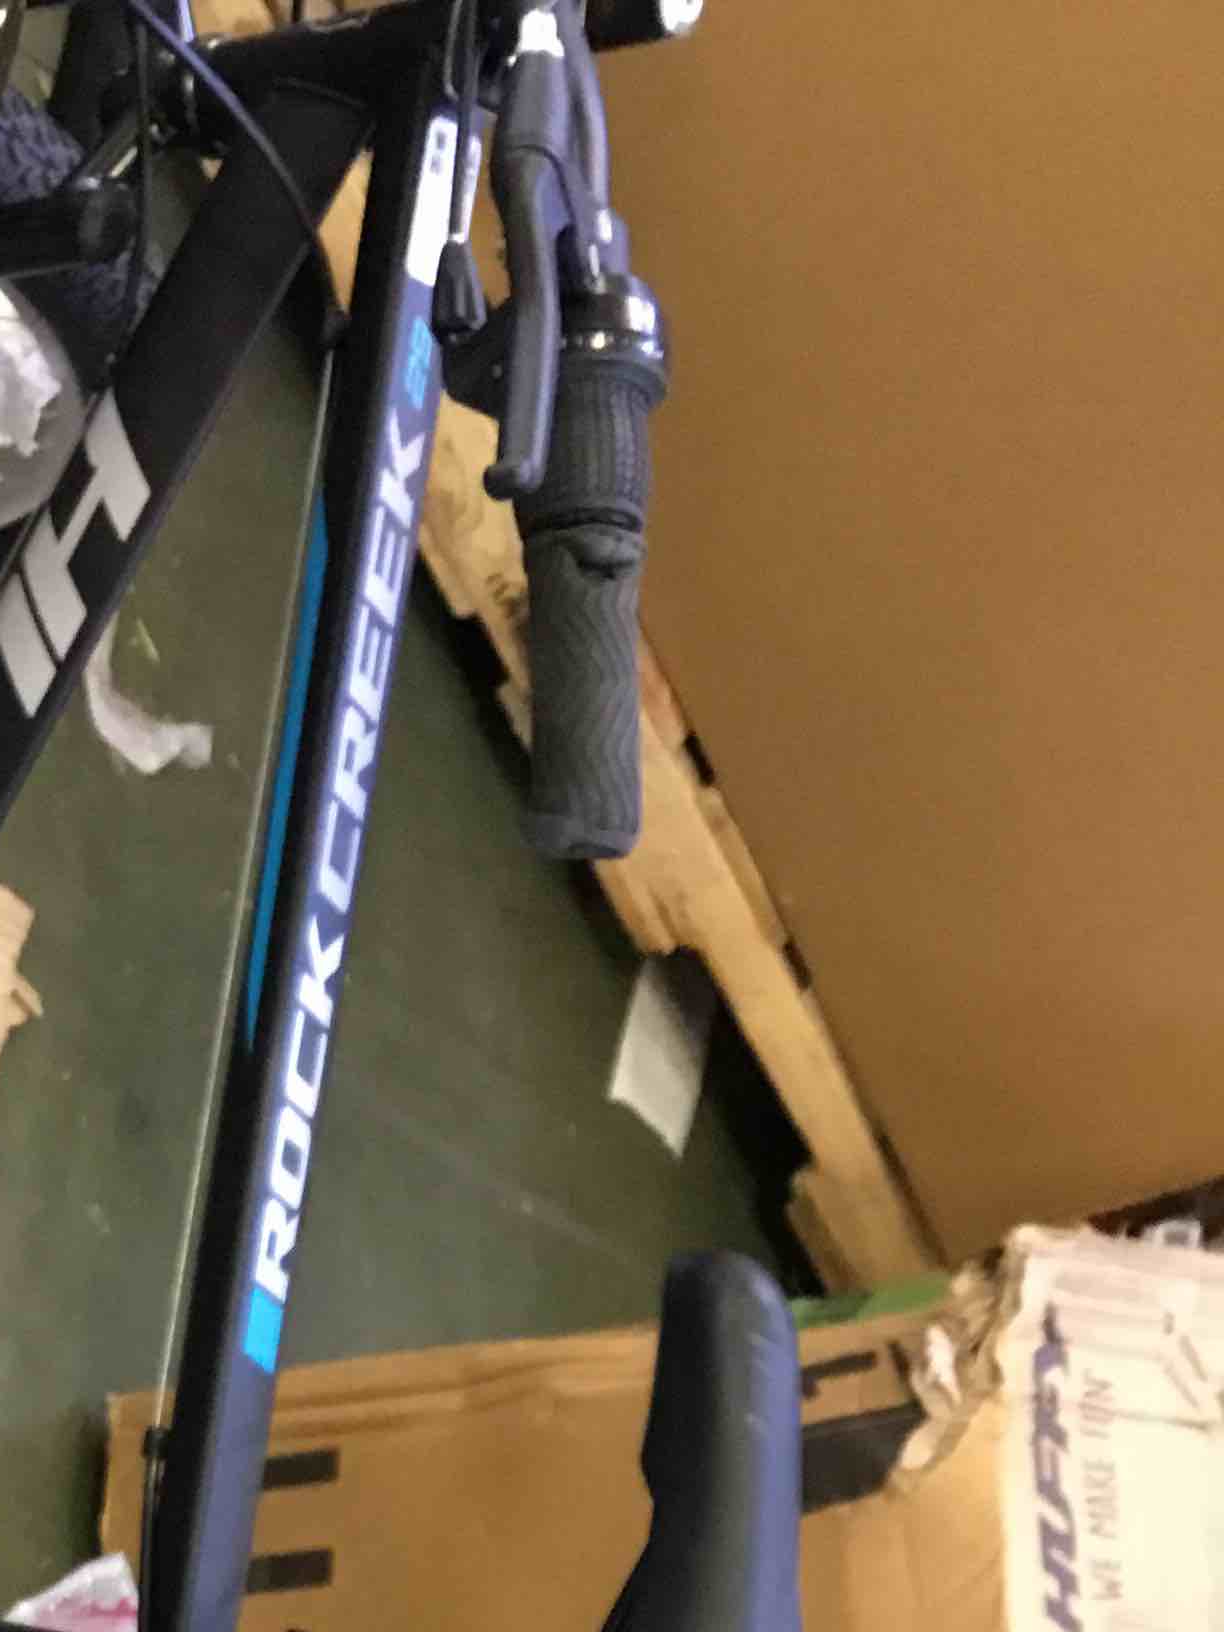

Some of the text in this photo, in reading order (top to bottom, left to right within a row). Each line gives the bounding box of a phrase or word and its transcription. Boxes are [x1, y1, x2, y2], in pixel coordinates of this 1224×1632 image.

[254, 918, 345, 1303] ROCK
[317, 410, 423, 909] CREEK
[1078, 1458, 1117, 1539] MAKE
[1087, 1560, 1122, 1600] WE
